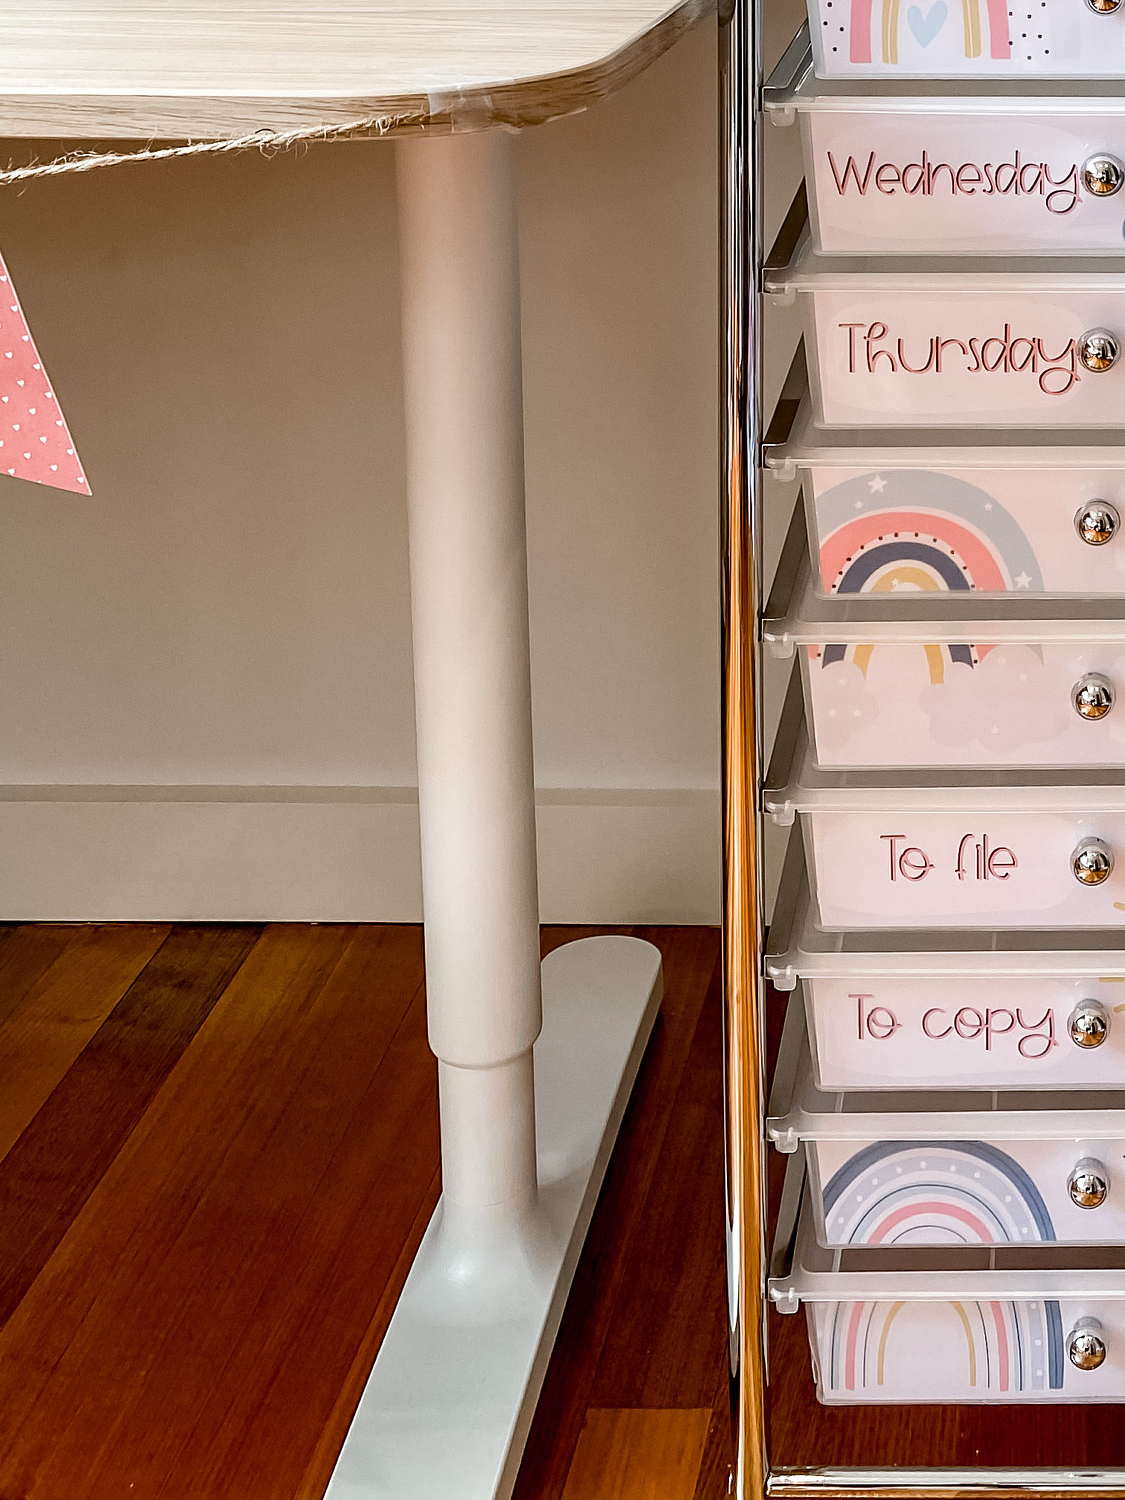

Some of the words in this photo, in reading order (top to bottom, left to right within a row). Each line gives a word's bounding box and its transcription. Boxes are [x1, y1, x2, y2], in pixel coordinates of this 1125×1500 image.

[826, 150, 1083, 215] Wednesday
[838, 323, 1082, 396] Thursday
[880, 834, 935, 883] To
[954, 833, 1018, 882] file
[848, 994, 903, 1041] To
[922, 1007, 1058, 1059] copy
